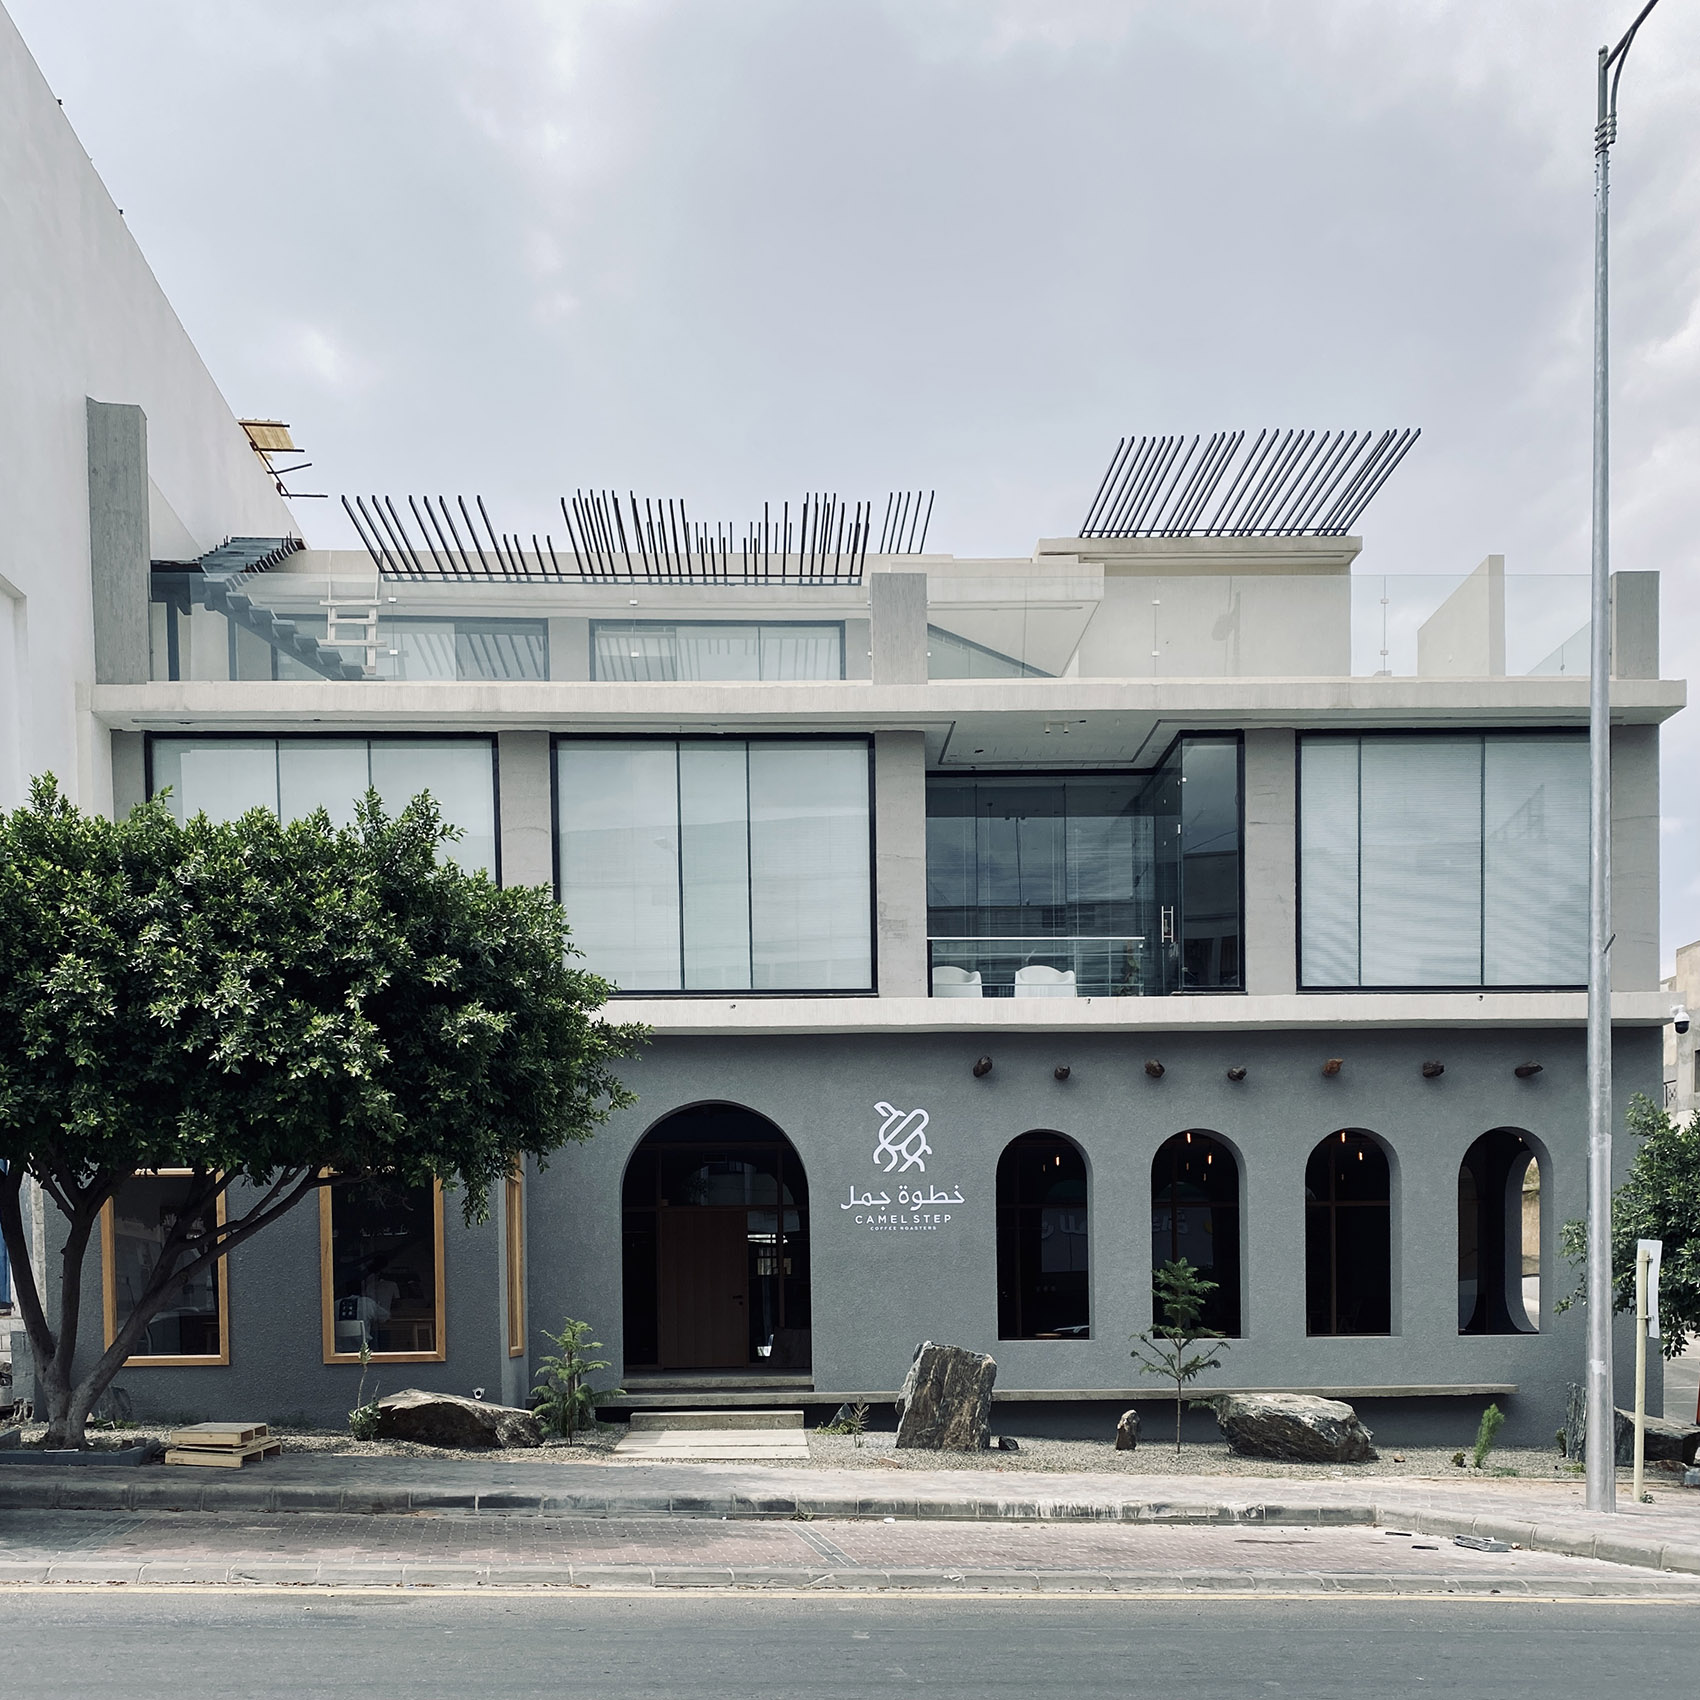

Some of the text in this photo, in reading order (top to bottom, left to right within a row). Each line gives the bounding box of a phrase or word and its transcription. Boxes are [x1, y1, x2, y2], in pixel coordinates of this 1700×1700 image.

[840, 1184, 966, 1211] خطوة جمل
[855, 1214, 952, 1224] CAMEL STEP
